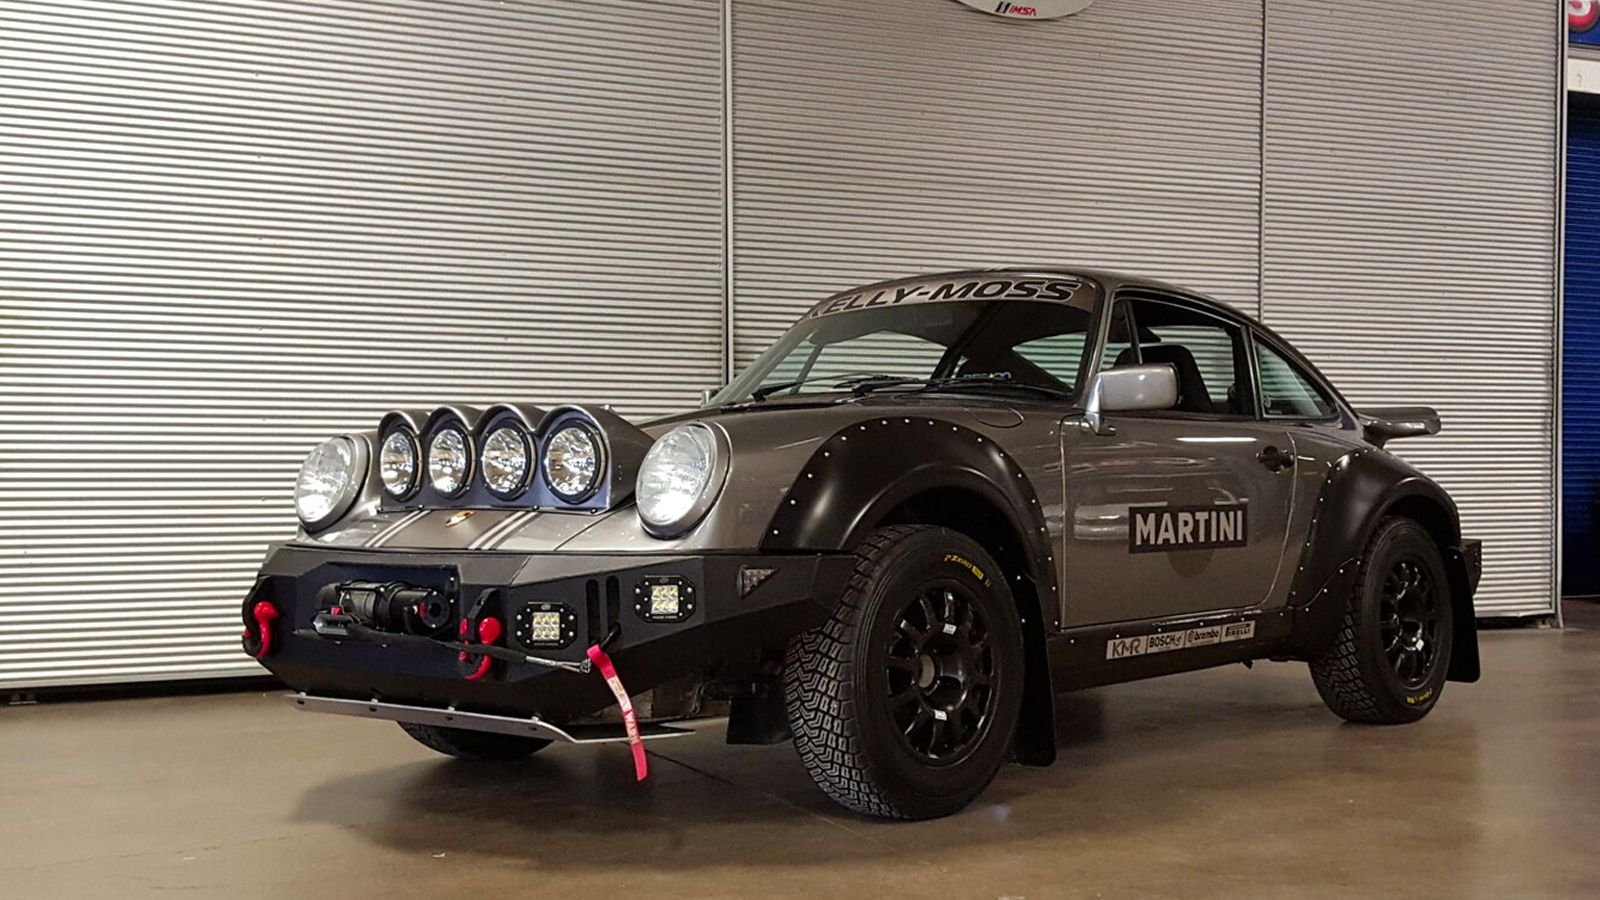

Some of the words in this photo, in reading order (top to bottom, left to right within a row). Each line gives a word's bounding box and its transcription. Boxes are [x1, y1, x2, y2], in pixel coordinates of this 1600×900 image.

[1009, 4, 1037, 16] IMSA
[1135, 510, 1243, 546] MARTINI
[1225, 623, 1251, 638] PIRELLI
[1111, 638, 1141, 658] KMR
[1149, 634, 1176, 648] BOSCH
